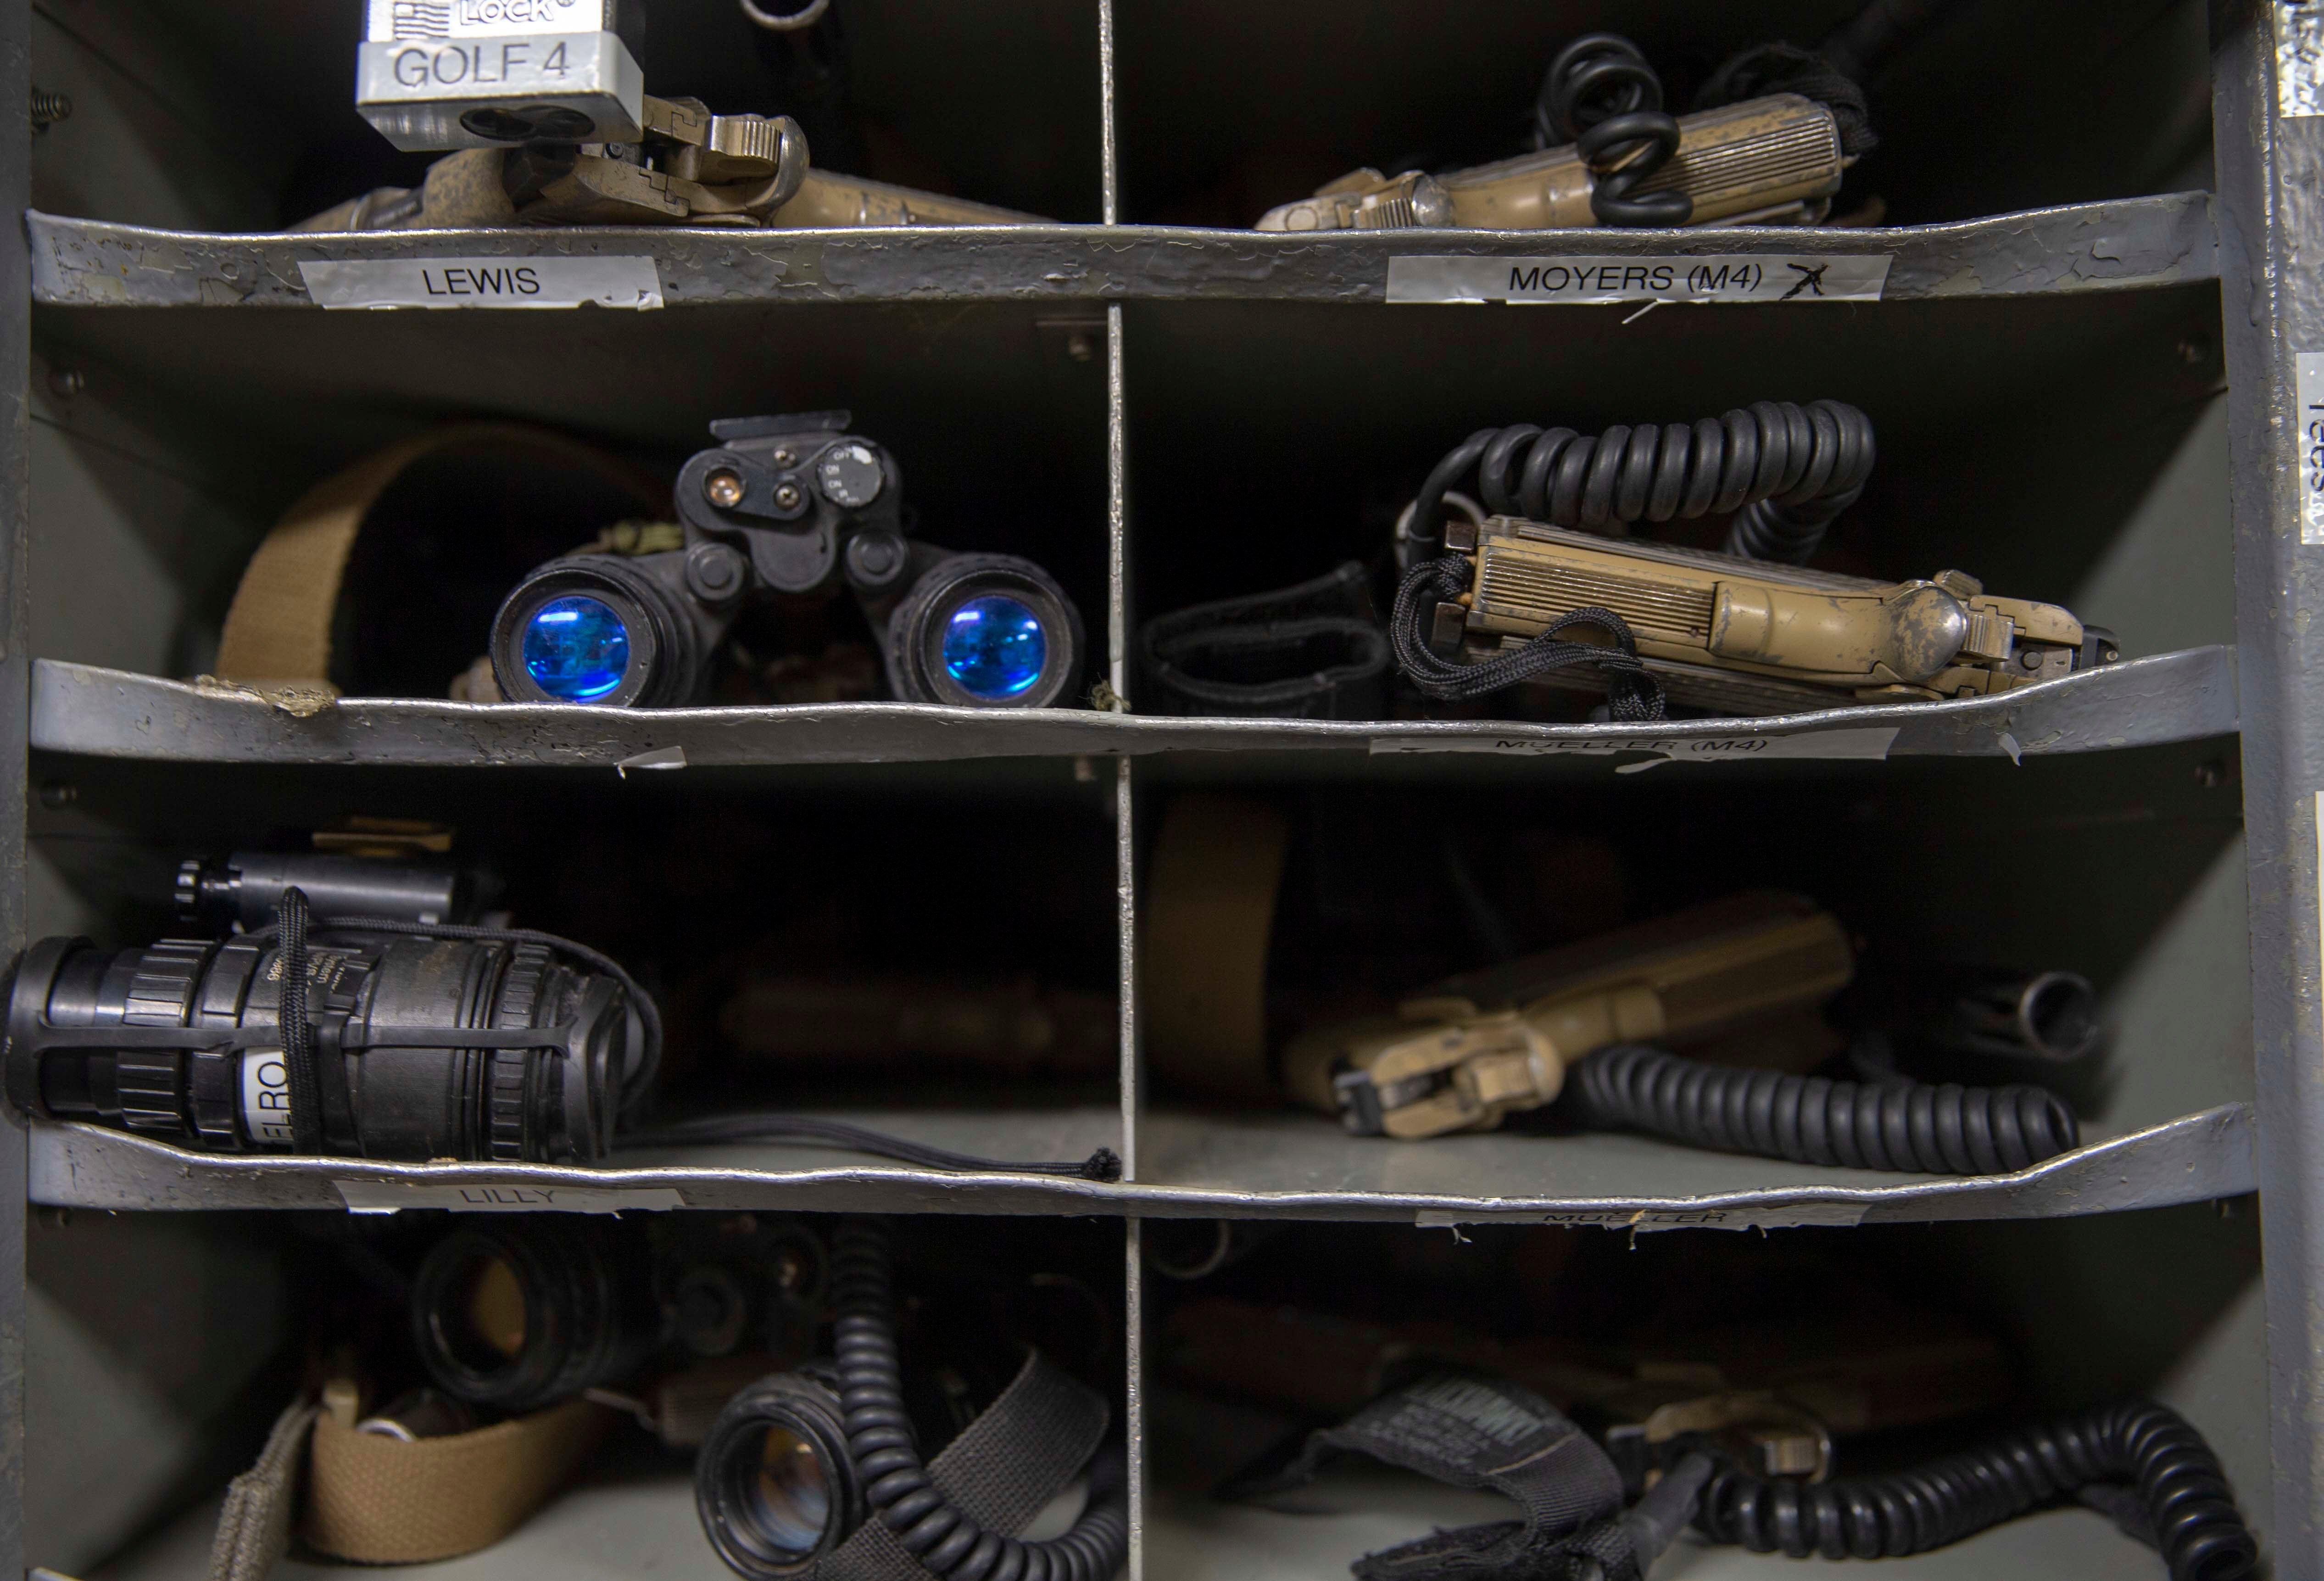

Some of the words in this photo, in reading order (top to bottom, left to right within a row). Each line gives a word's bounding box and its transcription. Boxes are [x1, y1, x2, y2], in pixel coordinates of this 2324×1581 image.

[460, 0, 553, 25] LOCK
[394, 44, 529, 87] GOLF
[543, 42, 569, 76] 4
[423, 268, 540, 295] LEWIS
[1510, 265, 1674, 291] MOYERS
[1687, 263, 1762, 292] (M4)
[1495, 739, 1678, 750] MUELLER
[1690, 739, 1769, 752] (M4)
[459, 1189, 555, 1203] LILLY
